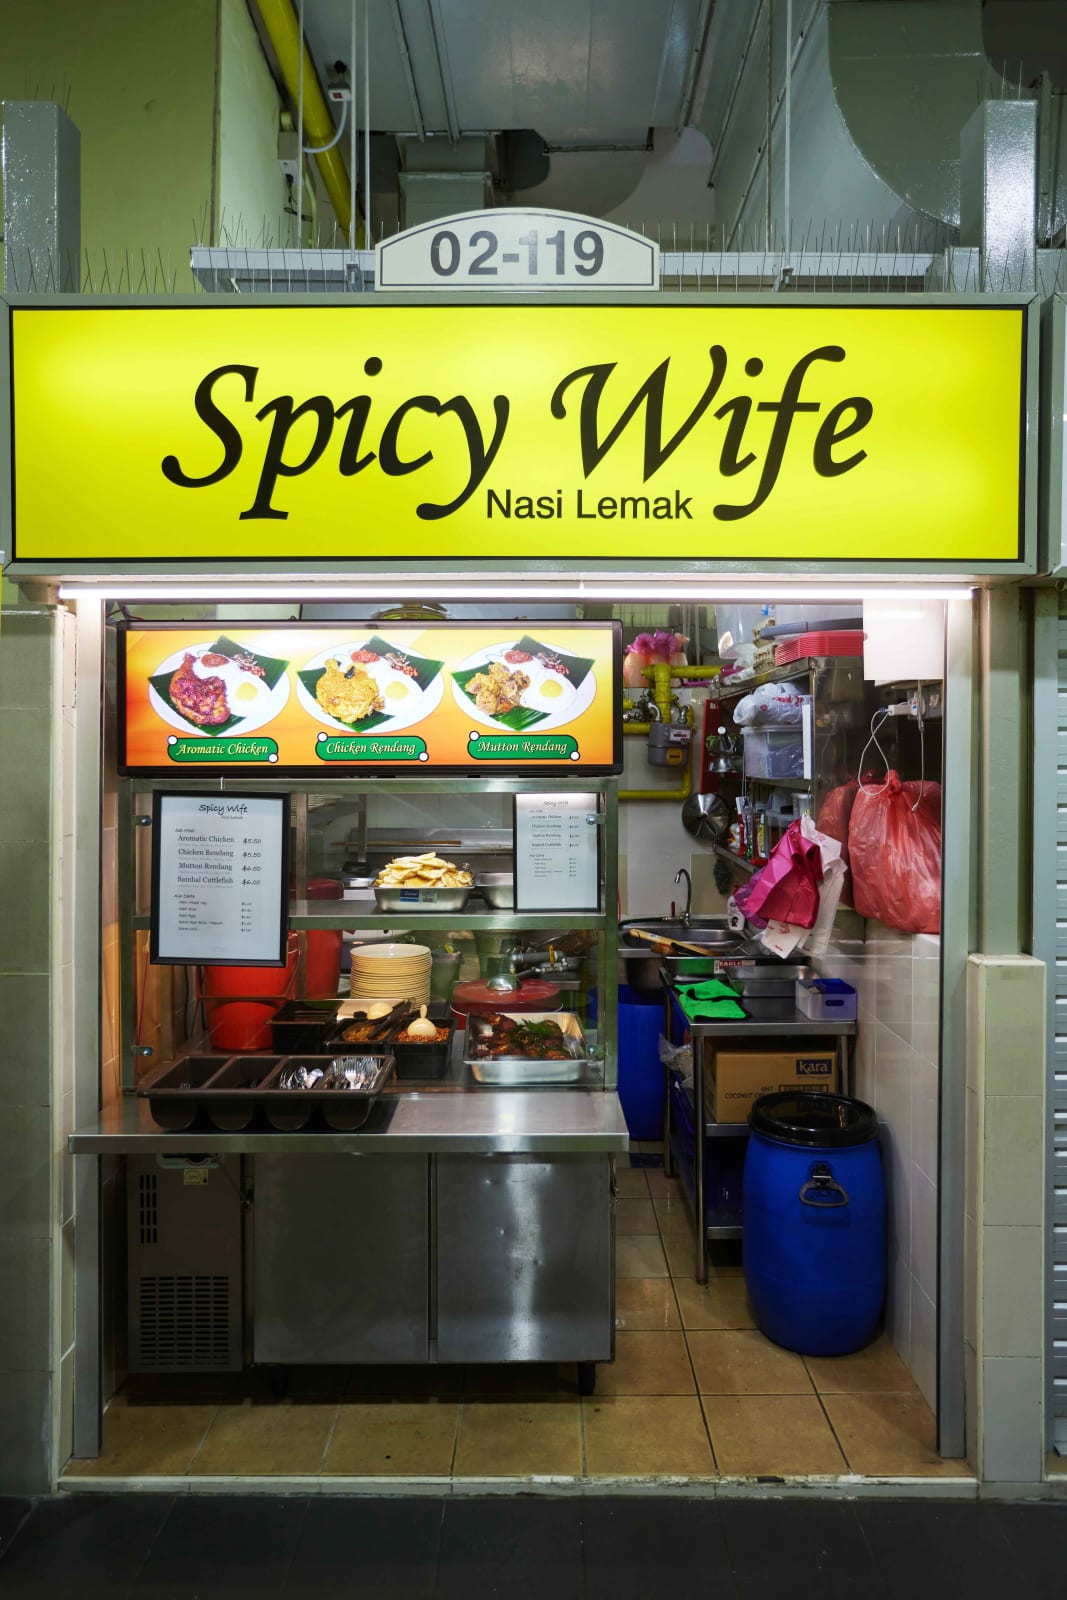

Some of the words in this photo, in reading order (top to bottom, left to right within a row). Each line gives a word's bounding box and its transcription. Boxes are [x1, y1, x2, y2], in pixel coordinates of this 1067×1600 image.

[430, 230, 604, 276] 02-119
[161, 356, 510, 521] Spicy
[550, 344, 874, 522] Wife
[486, 489, 562, 519] Nasi
[577, 489, 693, 519] Lemak
[176, 743, 225, 756] Aromatic
[228, 741, 269, 756] Chicken
[326, 740, 367, 755] Chicken
[370, 740, 416, 756] Rendang
[478, 741, 519, 753] Mutton
[522, 739, 568, 754] Rendang
[199, 804, 225, 816] Spicy
[227, 803, 248, 815] Wife
[208, 835, 235, 843] Chicken
[178, 848, 204, 856] Chicken
[205, 849, 234, 858] Rendang
[204, 863, 233, 871] Rendang
[799, 1060, 829, 1074] kara
